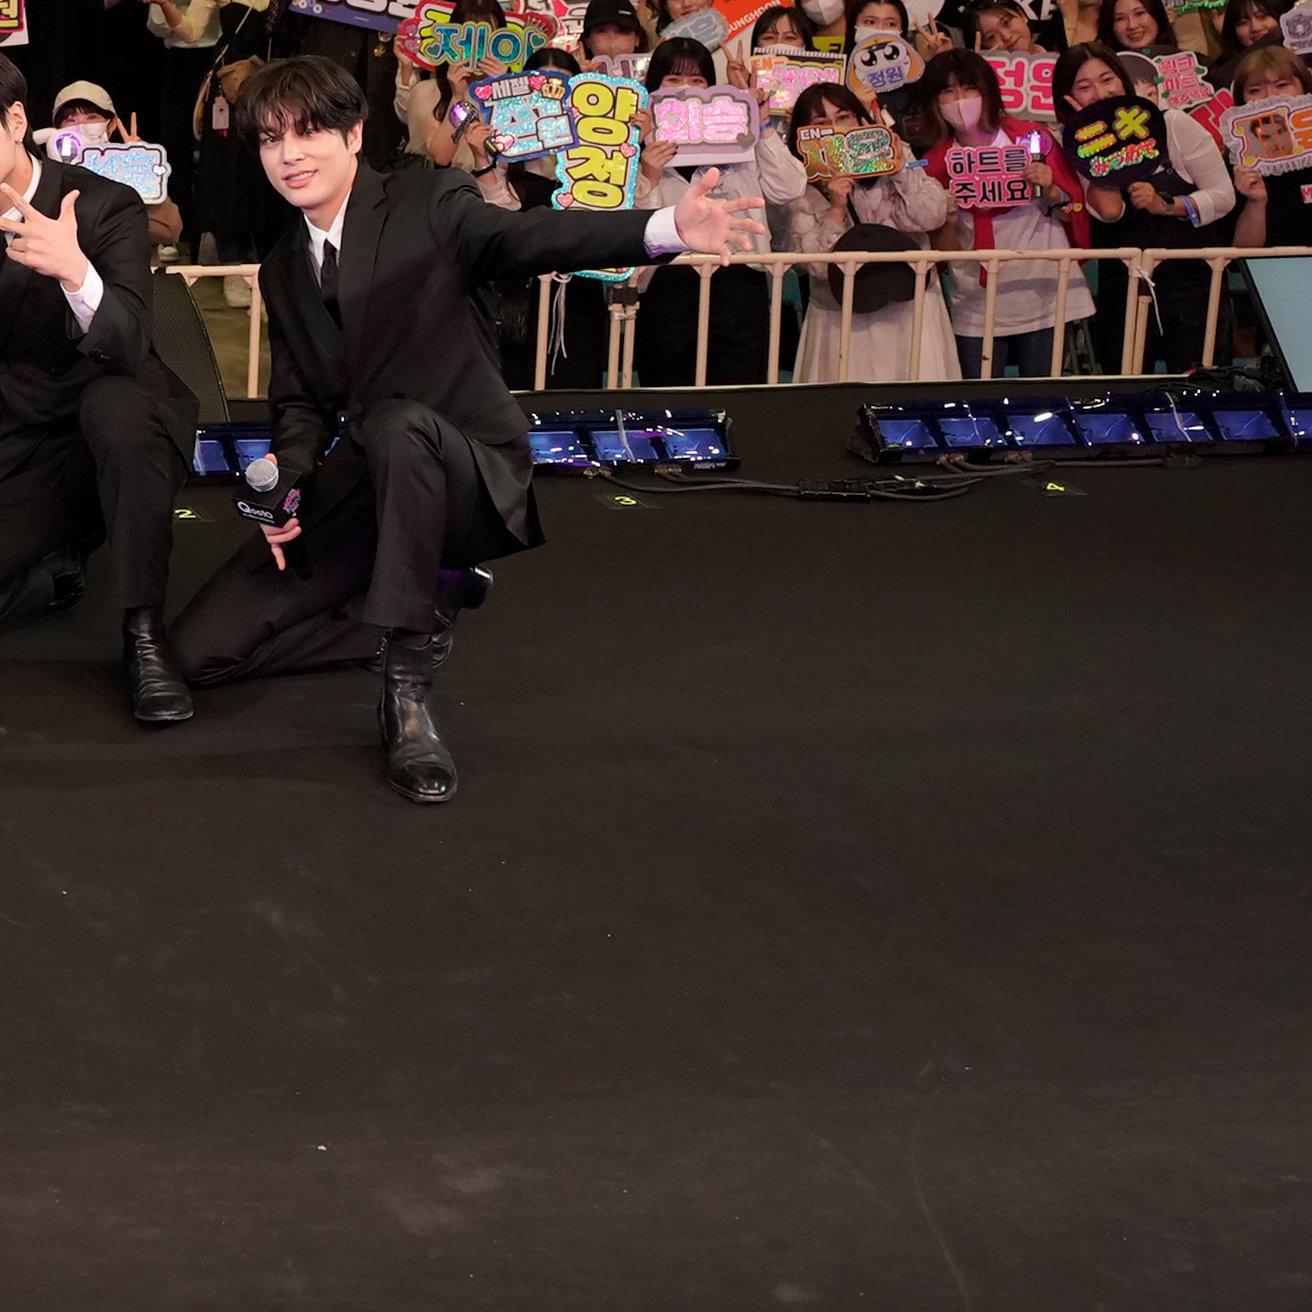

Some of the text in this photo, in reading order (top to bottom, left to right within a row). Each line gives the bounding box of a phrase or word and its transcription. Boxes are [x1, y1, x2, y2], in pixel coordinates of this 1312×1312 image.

[726, 0, 781, 34] UNGHOON
[434, 24, 531, 68] 제이
[867, 66, 907, 88] 정원
[991, 59, 1058, 114] 정원
[571, 81, 639, 211] 양정
[1074, 106, 1151, 161] ニキ
[950, 151, 1028, 177] 하트를
[952, 180, 1032, 205] 주세요
